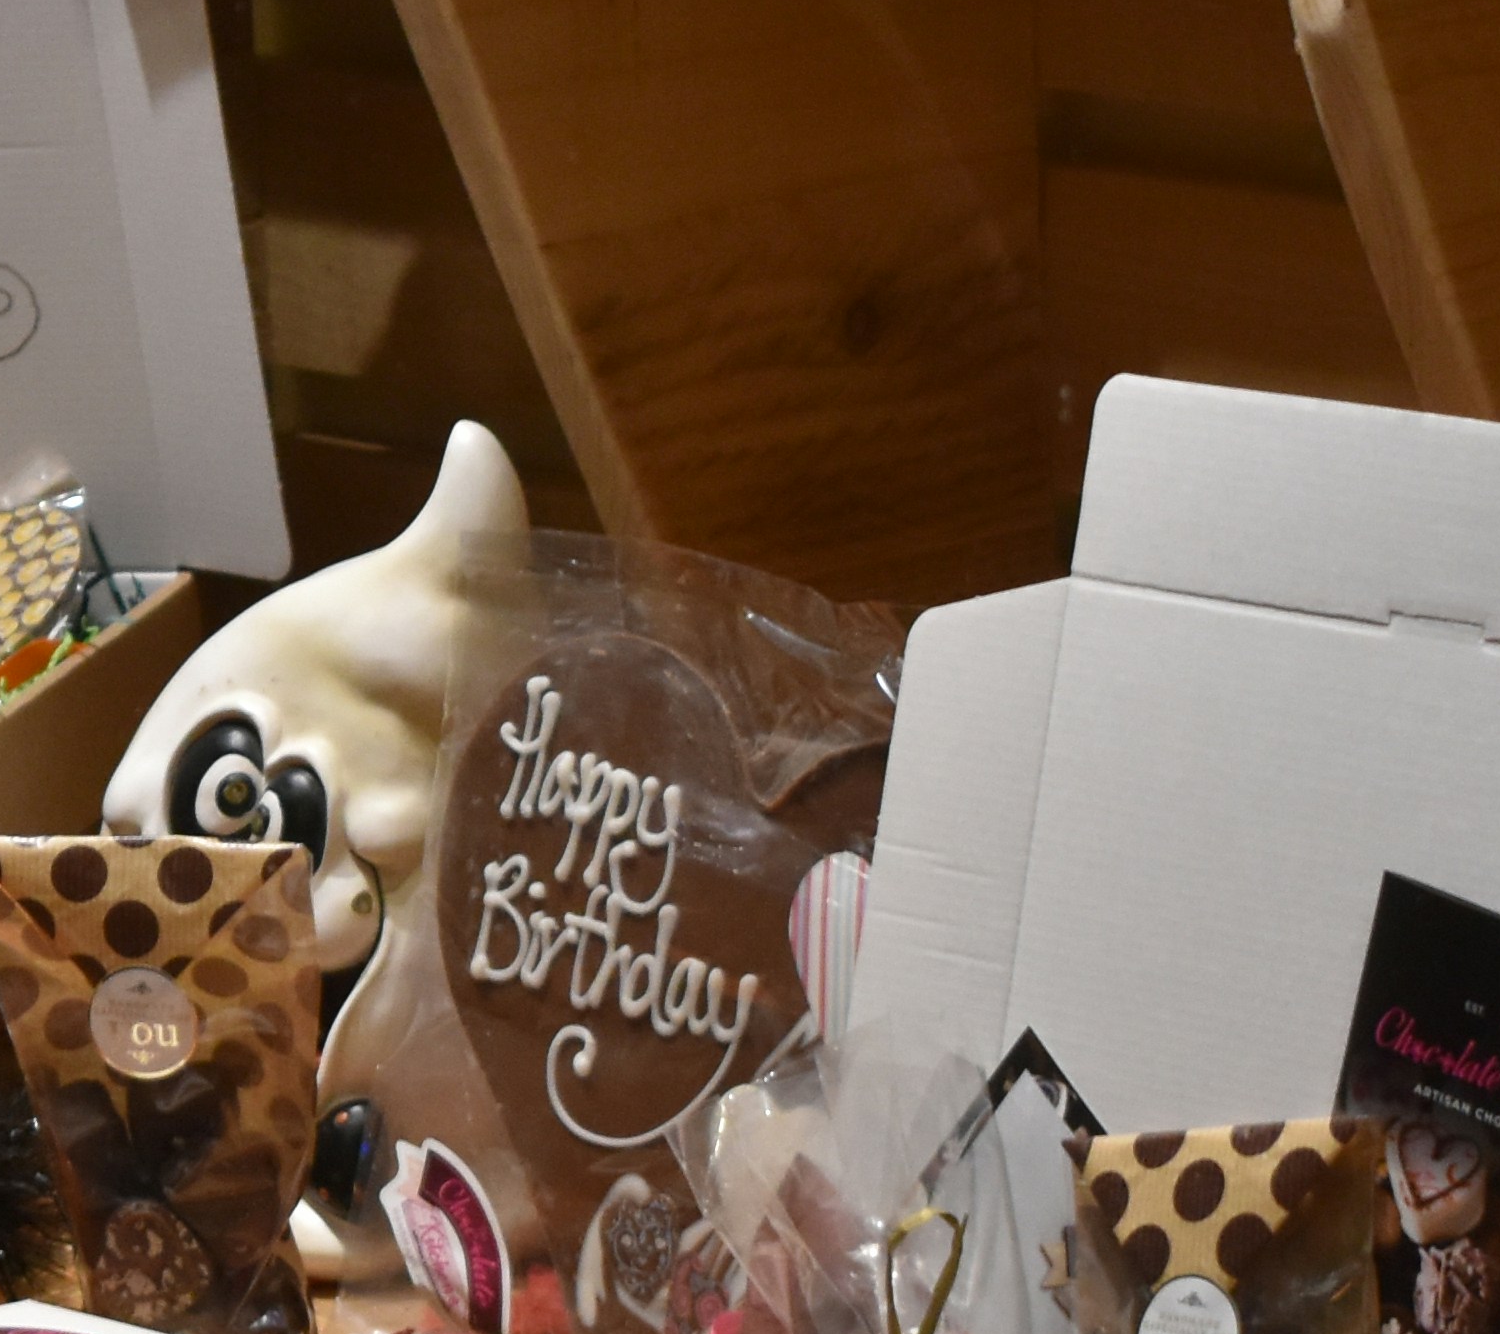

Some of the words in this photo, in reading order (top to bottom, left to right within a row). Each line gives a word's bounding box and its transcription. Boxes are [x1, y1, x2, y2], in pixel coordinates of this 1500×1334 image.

[500, 675, 681, 915] Happy
[470, 854, 759, 1147] Birthday
[1413, 1083, 1471, 1115] ARTISAN
